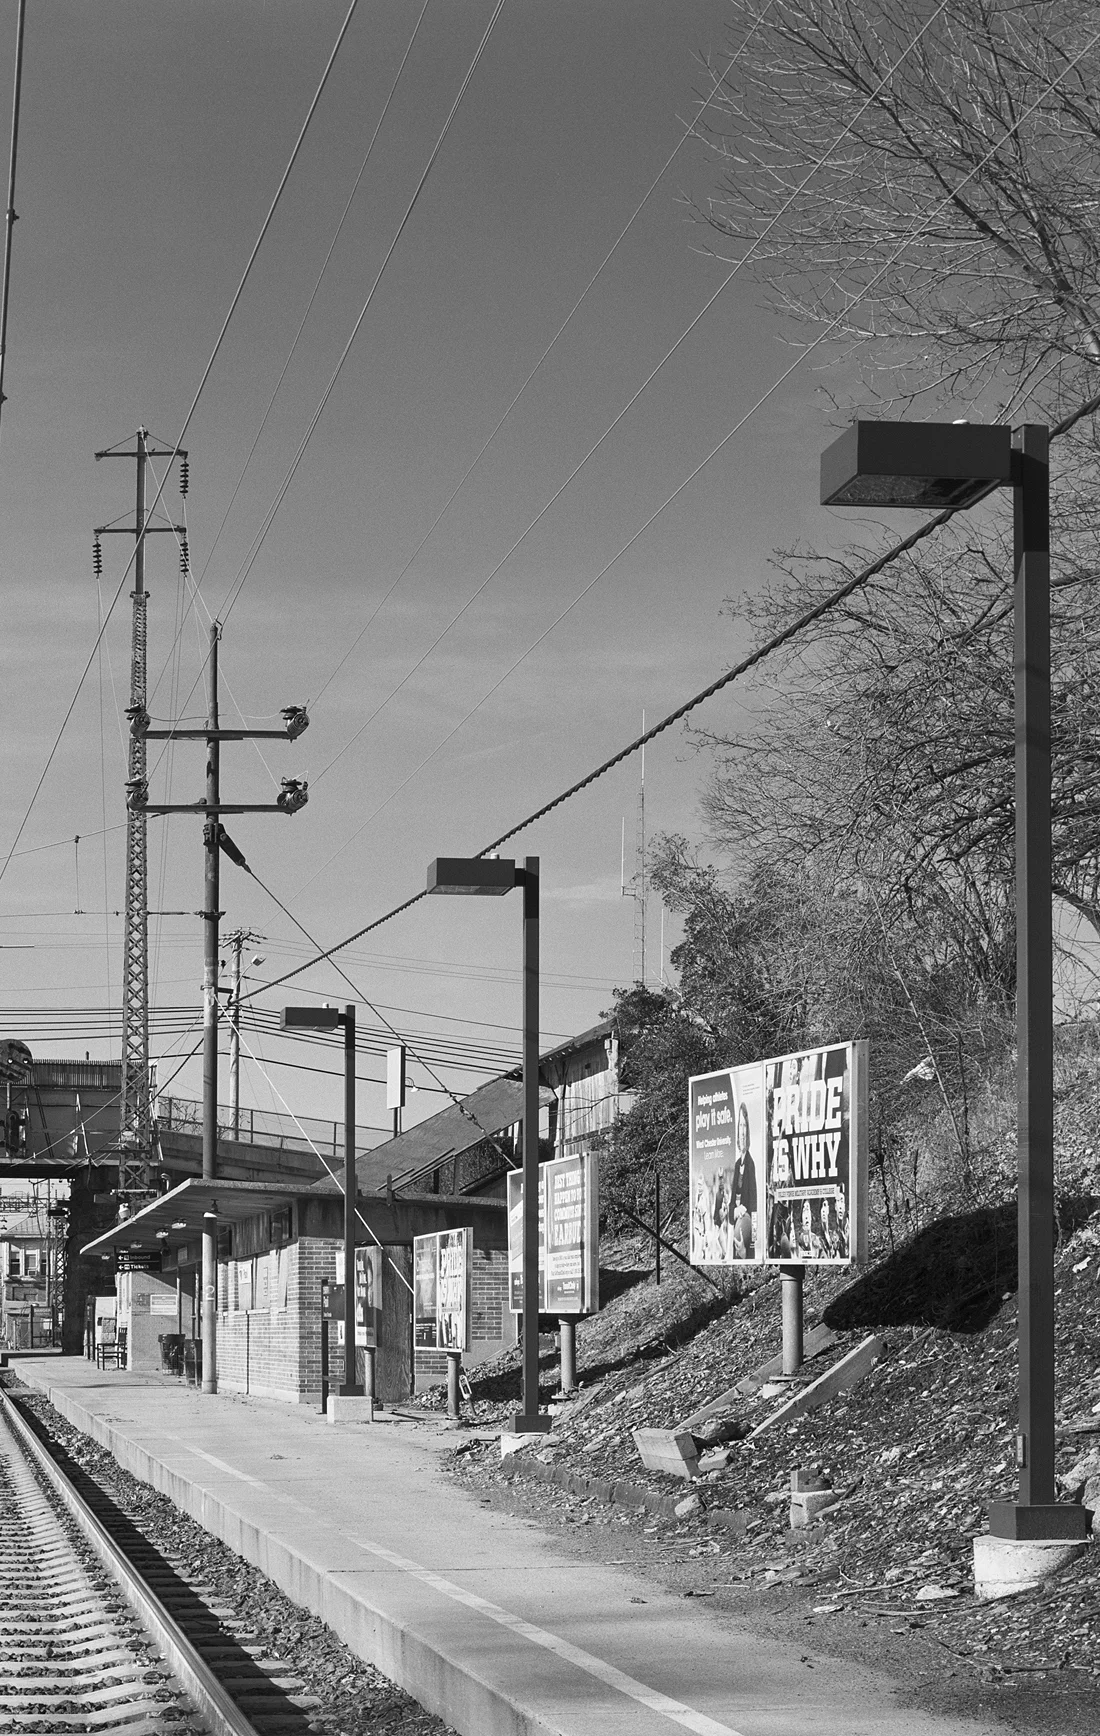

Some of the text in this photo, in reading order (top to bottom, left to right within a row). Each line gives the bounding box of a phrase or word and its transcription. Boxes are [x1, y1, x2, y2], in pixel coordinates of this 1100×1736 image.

[695, 1106, 733, 1133] play it safe.
[772, 1076, 843, 1137] PRIDE
[704, 1151, 714, 1160] Learn
[773, 1132, 841, 1182] IS WHY
[205, 1285, 215, 1301] 2
